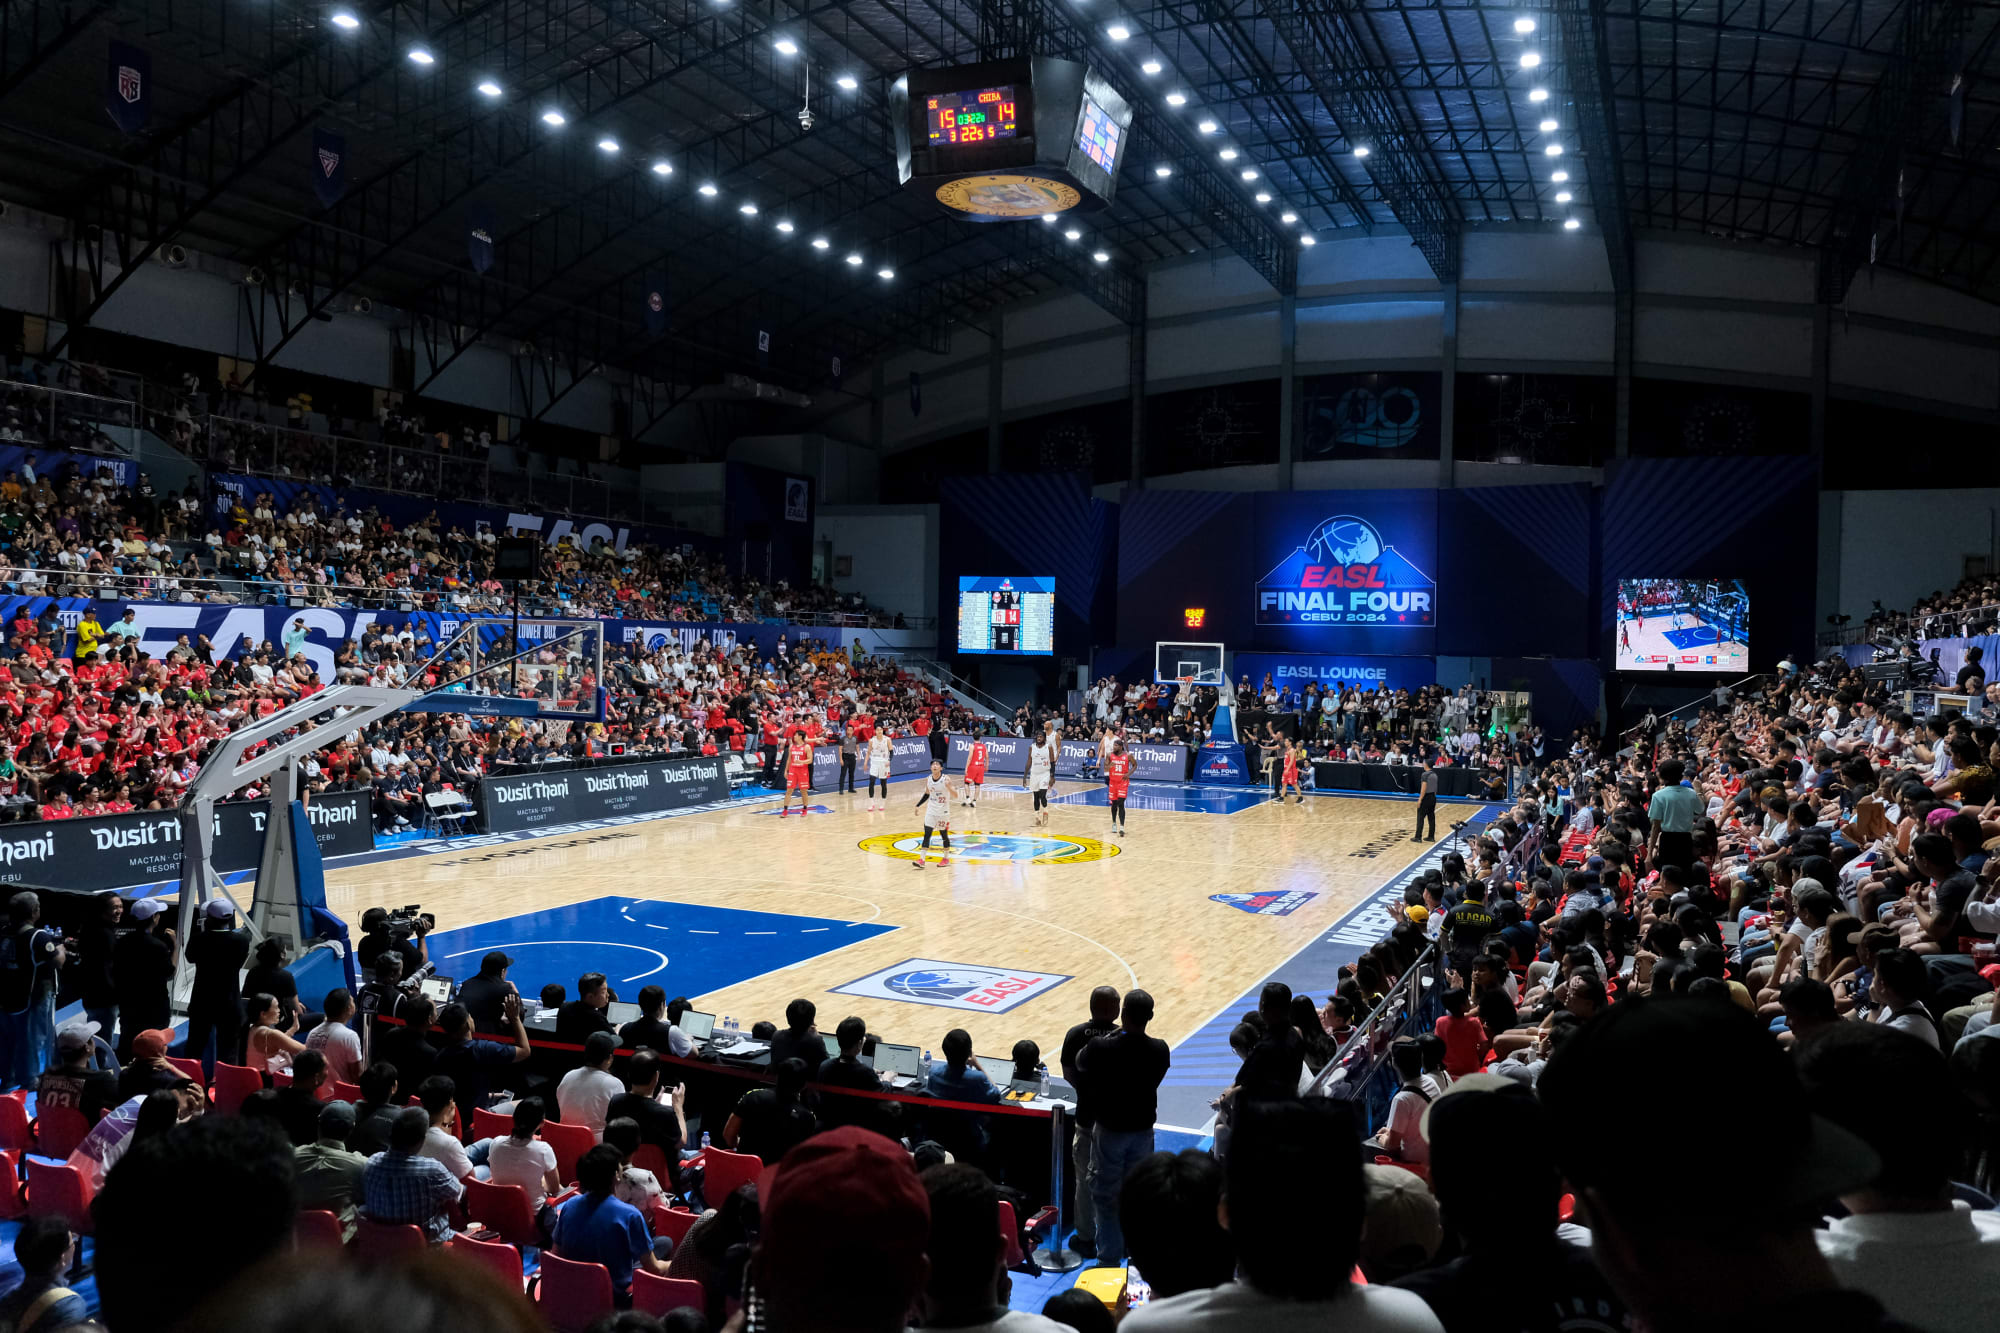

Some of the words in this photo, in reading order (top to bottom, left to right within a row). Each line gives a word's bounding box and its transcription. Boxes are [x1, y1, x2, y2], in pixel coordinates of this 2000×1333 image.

[978, 92, 1002, 103] CHIBA
[940, 108, 955, 129] 15
[998, 102, 1015, 122] 14
[1300, 565, 1385, 588] EASL
[1260, 591, 1344, 611] FINAL
[1350, 591, 1431, 612] FOUR
[1188, 616, 1201, 627] 22
[1300, 613, 1341, 622] CEBU
[1345, 613, 1387, 622] 2024
[518, 624, 543, 639] LOWER
[543, 625, 558, 639] BOX
[1277, 665, 1318, 679] EASL
[1320, 667, 1387, 681] LOUNGE
[908, 740, 926, 756] Thani
[986, 741, 1017, 756] Thani
[1063, 745, 1095, 760] Than
[816, 750, 837, 767] Thani
[1144, 748, 1177, 765] Thani
[662, 766, 691, 783] Dusit
[690, 762, 718, 782] Thani
[584, 773, 618, 793] Dusit
[617, 770, 649, 791] Thani
[494, 782, 533, 803] Dusit
[532, 778, 570, 801] Thani
[938, 796, 947, 804] 22
[308, 800, 358, 828] Thani
[517, 808, 540, 817] MACTAN
[542, 806, 556, 814] CEBU
[527, 814, 548, 822] RESORT
[91, 820, 159, 851] Dusit
[317, 834, 336, 842] CEBU
[416, 832, 519, 853] EAST
[130, 853, 167, 867] MACTAN
[146, 863, 181, 874] RESORT
[963, 977, 1043, 1006] EASL
